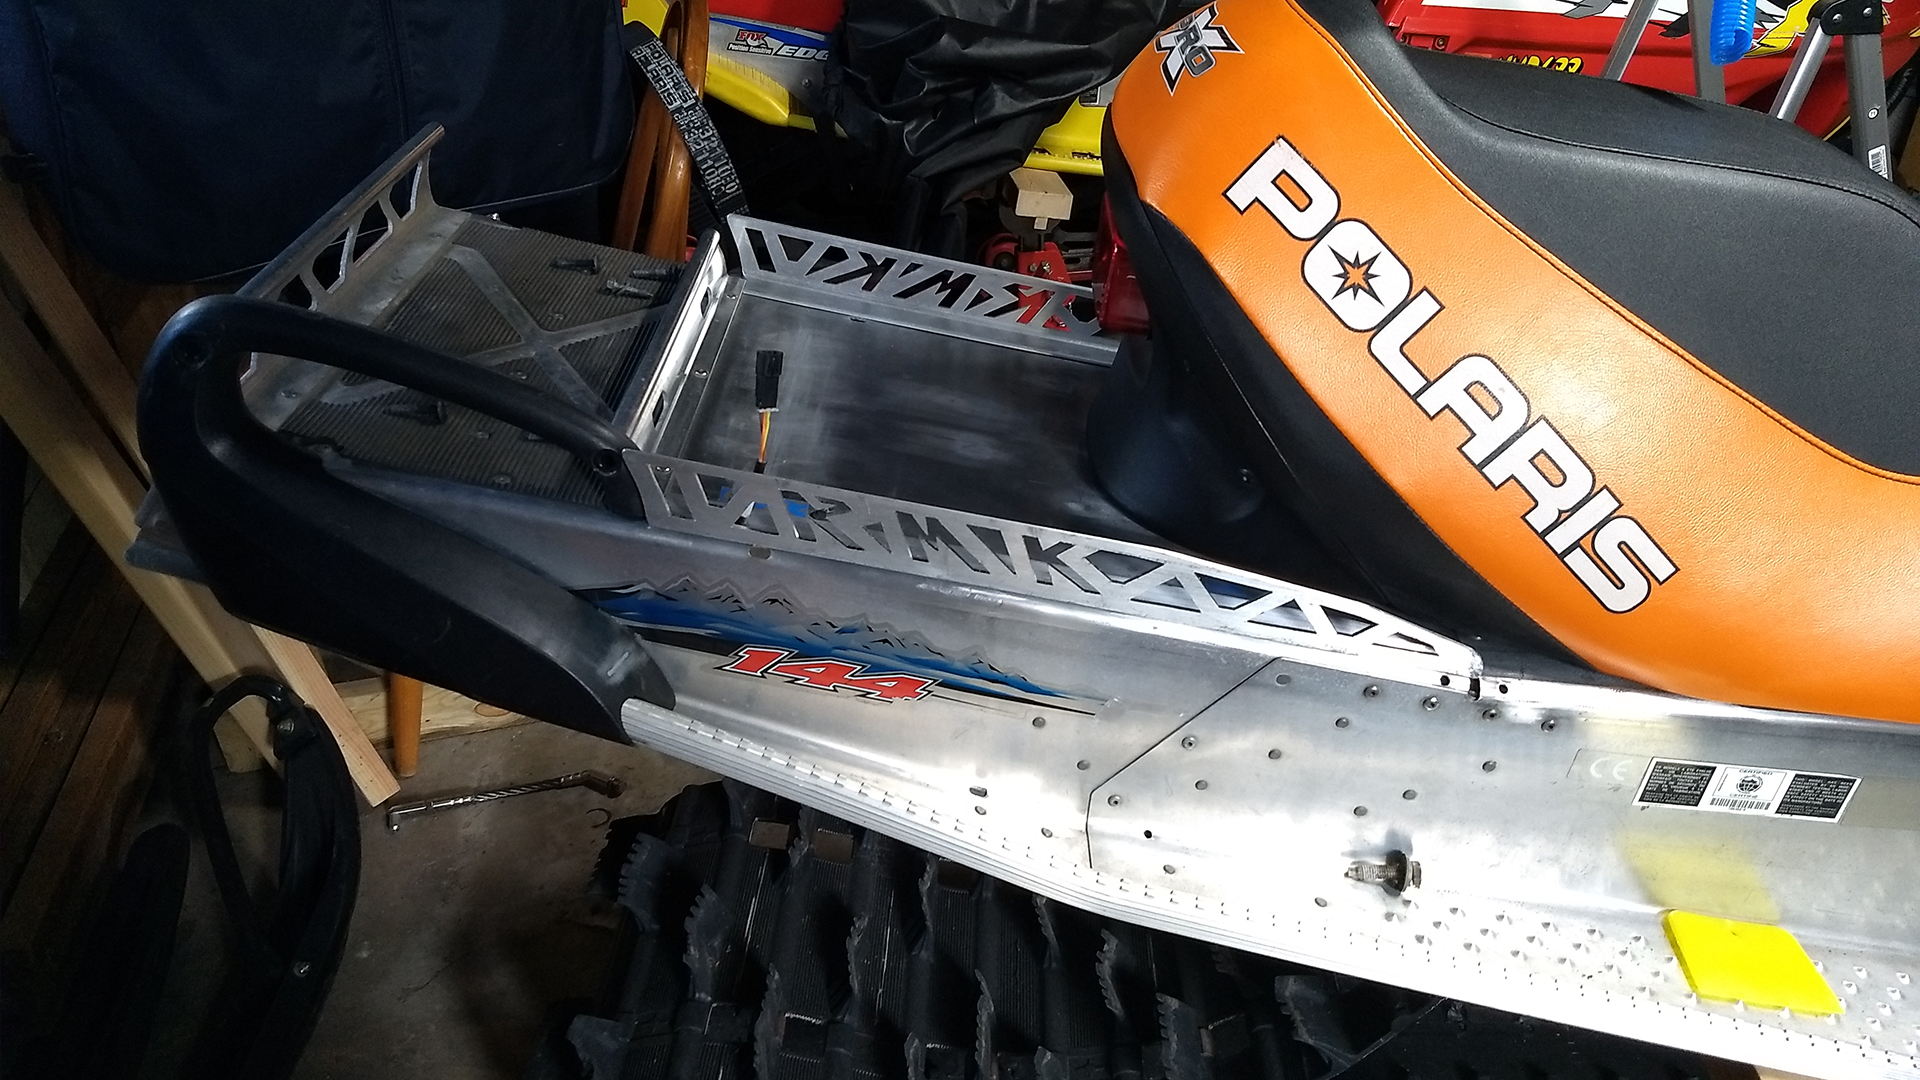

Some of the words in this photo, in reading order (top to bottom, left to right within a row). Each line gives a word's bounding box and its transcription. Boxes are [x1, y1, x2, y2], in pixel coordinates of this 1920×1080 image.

[728, 43, 749, 52] Position
[749, 46, 772, 54] Sensitive
[738, 30, 767, 43] FOX
[1221, 135, 1681, 614] POLARIS
[780, 488, 1101, 595] RMK
[716, 645, 938, 704] 144
[1589, 757, 1634, 782] CE
